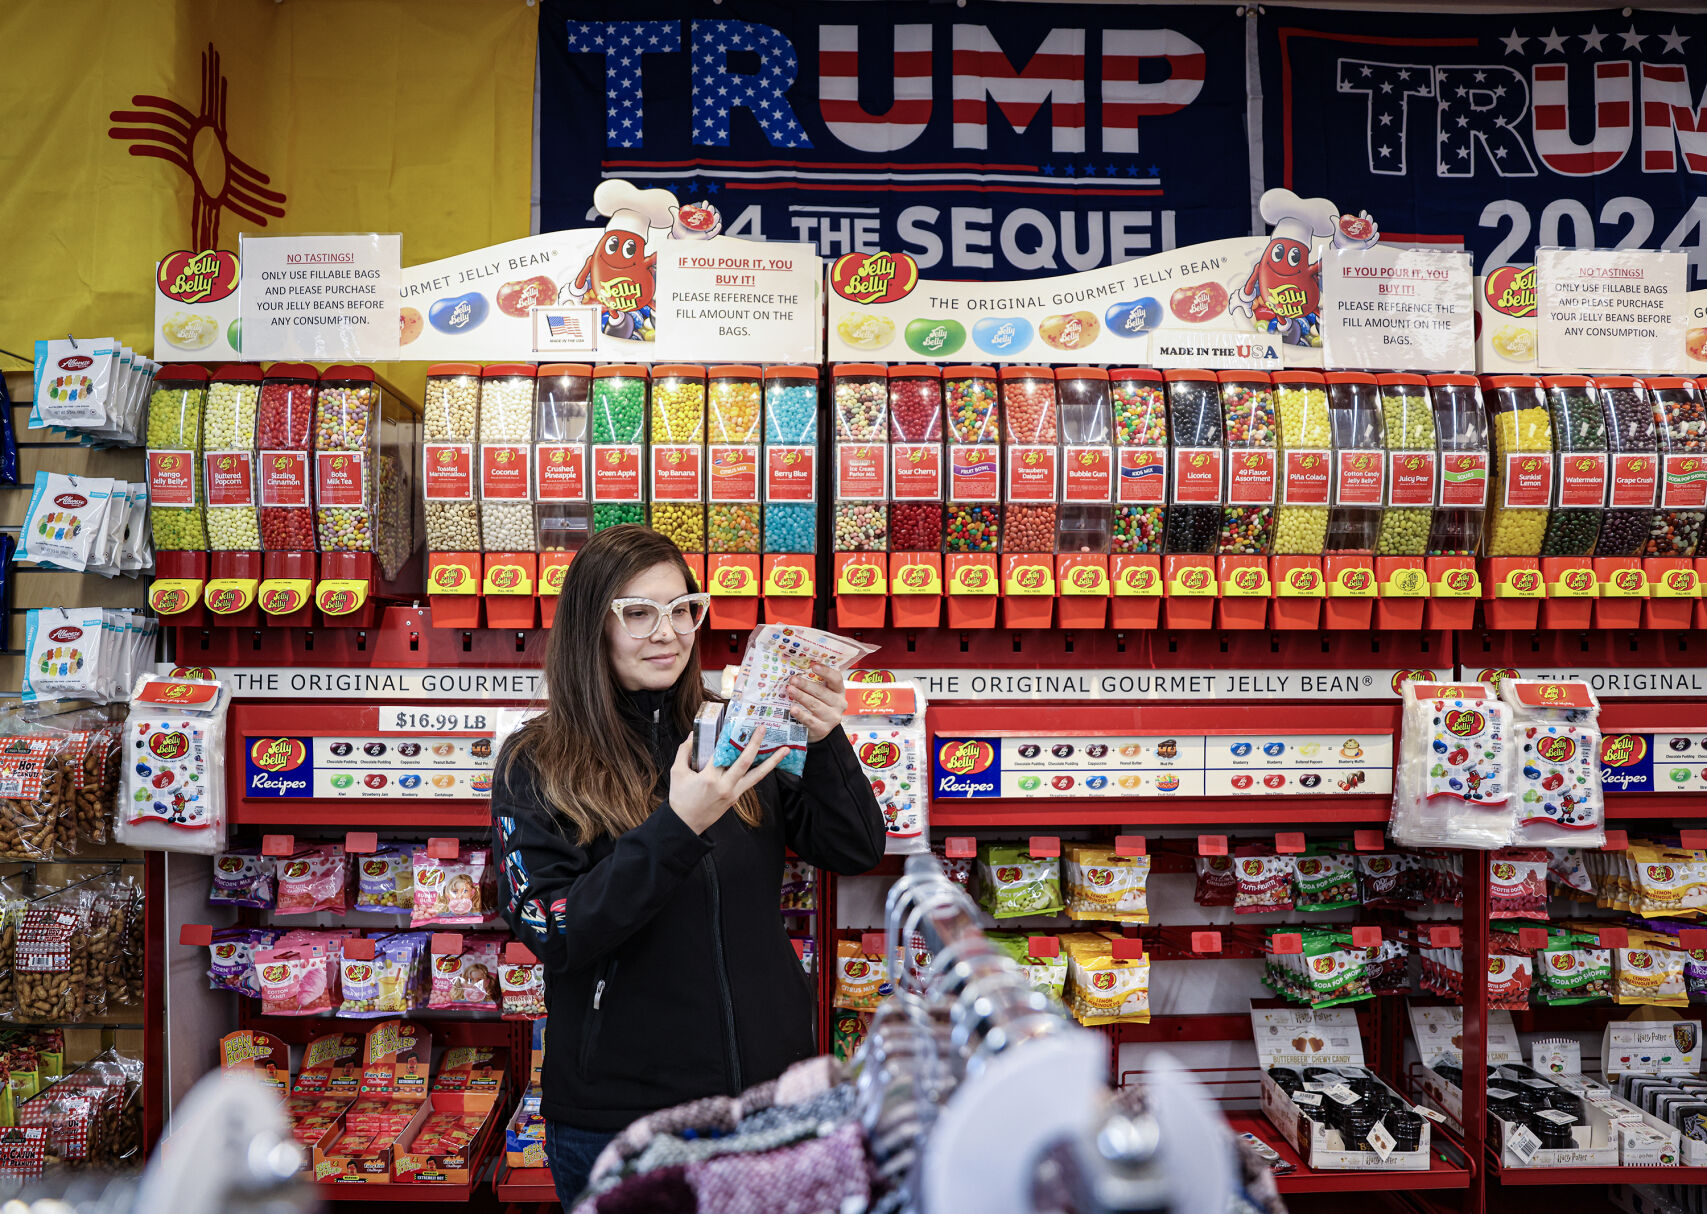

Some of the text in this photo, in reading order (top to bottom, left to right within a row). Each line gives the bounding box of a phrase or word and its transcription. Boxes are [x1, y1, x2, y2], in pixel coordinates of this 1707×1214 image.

[566, 19, 1205, 153] TRUMP
[791, 217, 879, 252] THE
[287, 253, 354, 262] NO TASTINGS!
[185, 251, 222, 277] Jelly
[679, 258, 792, 269] IF YOU POUR IT, YOU
[860, 253, 898, 278] Jelly
[262, 269, 380, 280] ONLY USE FILLABLE BAGS
[459, 262, 500, 284] JELLY
[1343, 268, 1448, 279] IF YOU POUR IT, YOU
[1579, 268, 1644, 276] NO TASTINGS!
[170, 271, 215, 295] Belly
[716, 275, 755, 284] BUY IT!
[265, 285, 376, 295] AND PLEASE PURCHASE
[844, 274, 890, 298] Belly
[930, 296, 959, 310] THE
[968, 296, 1045, 311] ORIGINAL
[1052, 280, 1125, 306] GOURMET
[1133, 268, 1172, 288] JELLY
[1379, 285, 1414, 294] BUY IT!
[1555, 284, 1668, 294] ONLY USE FILLABLE BAGS
[672, 293, 798, 304] PLEASE REFERENCE THE
[1559, 299, 1664, 308] AND PLEASE PURCHASE
[257, 300, 384, 310] YOUR JELLY BEANS BEFORE
[1338, 302, 1454, 313] PLEASE REFERENCE THE
[676, 310, 793, 320] FILL AMOUNT ON THE
[1550, 312, 1671, 324] YOUR JELLY BEANS BEFORE
[271, 316, 370, 326] ANY CONSUMPTION.
[1343, 318, 1450, 329] FILL AMOUNT ON THE
[719, 327, 750, 336] BAGS.
[1564, 328, 1658, 338] ANY CONSUMPTION.
[1383, 336, 1412, 345] BAGS.
[1160, 346, 1278, 359] MADE IN THE USA
[158, 472, 180, 480] Mango
[271, 472, 296, 480] Sizzling
[545, 472, 576, 480] Pineapple
[618, 470, 636, 478] Apple
[658, 470, 669, 478] Top
[774, 470, 792, 478] Berry
[914, 468, 936, 477] Cherry
[1363, 470, 1379, 478] Candy
[153, 478, 166, 486] Jelly
[1398, 475, 1414, 483] Juicy
[234, 674, 540, 691] THE ORIGINAL GOURMET
[972, 676, 1090, 693] ORIGINAL
[1102, 676, 1216, 692] GOURMET
[1226, 676, 1289, 692] JELLY
[1591, 674, 1701, 690] ORIGINAL
[396, 711, 487, 730] $16.99 LB
[268, 739, 292, 756] Jelly
[1612, 737, 1634, 751] Jelly
[956, 743, 980, 760] Jelly
[1604, 749, 1629, 764] Belly
[18, 761, 36, 770] HOT
[259, 753, 288, 769] Belly
[947, 756, 974, 772] Belly
[252, 772, 306, 796] Recipes
[940, 776, 993, 798] Recipes
